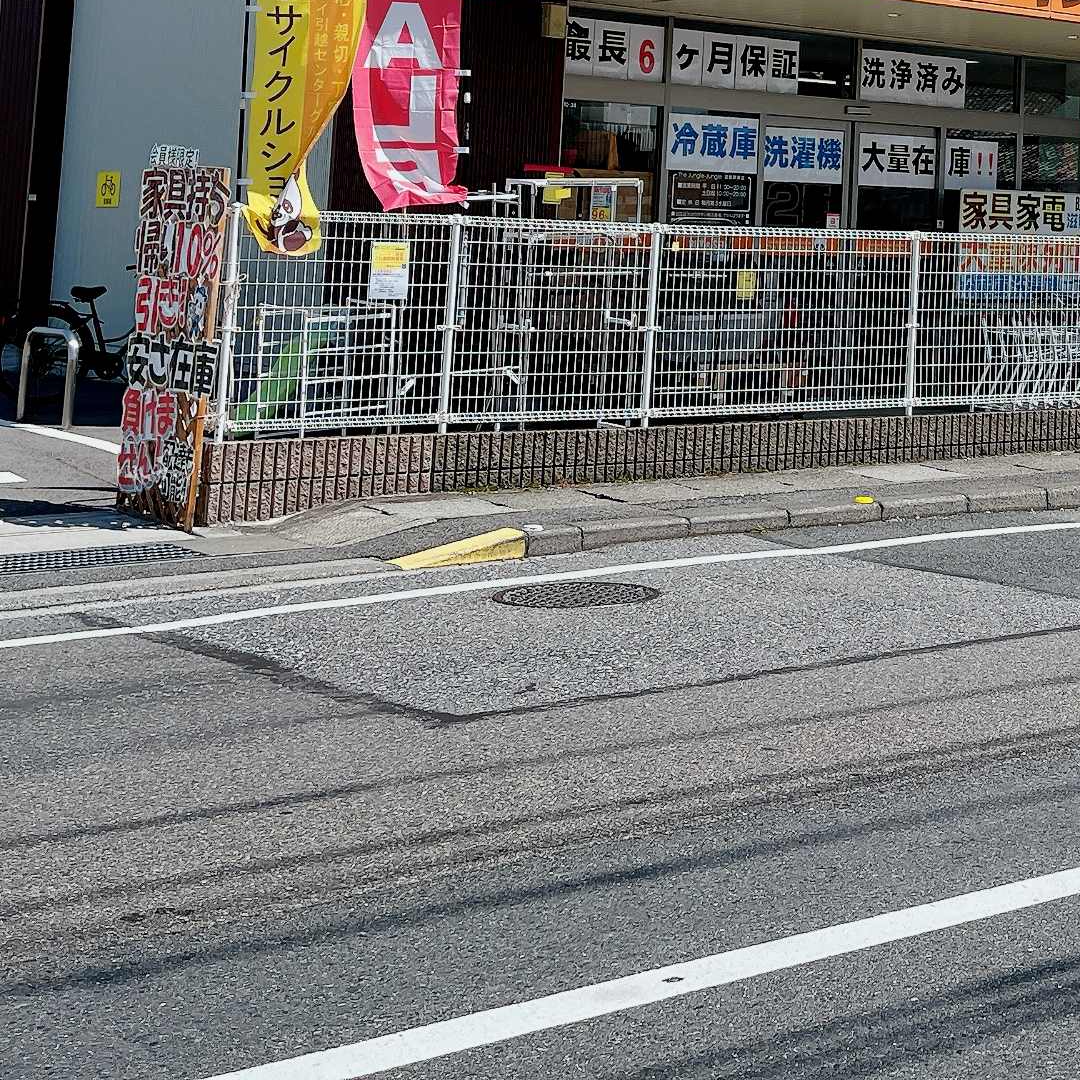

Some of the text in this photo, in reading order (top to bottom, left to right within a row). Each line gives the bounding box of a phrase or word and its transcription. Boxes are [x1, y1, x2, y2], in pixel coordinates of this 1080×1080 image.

[862, 56, 965, 95] 洗浄済み
[670, 122, 758, 160] 冷蔵庫
[763, 135, 841, 171] 洗濯機
[861, 141, 994, 178] 大量在庫!!
[140, 166, 231, 224] 家具持ち
[962, 191, 1066, 232] 家具家電
